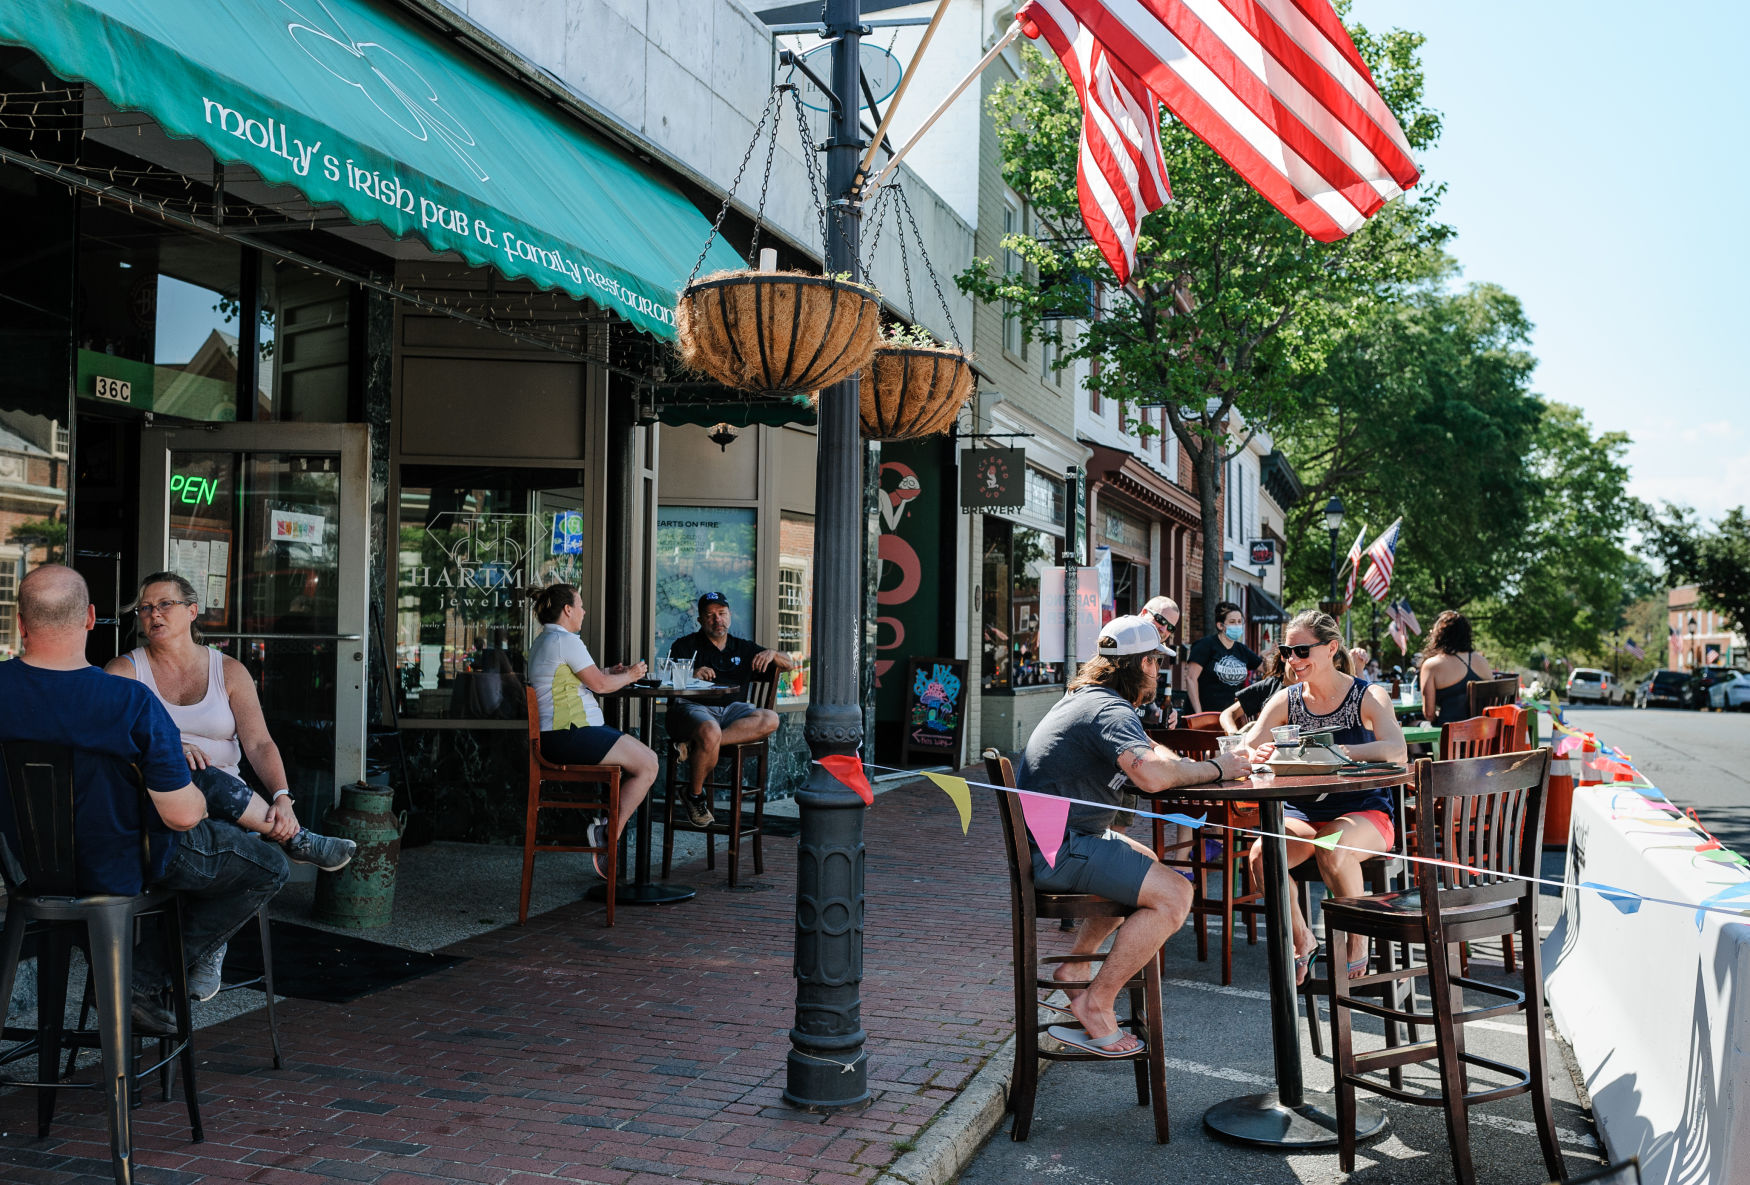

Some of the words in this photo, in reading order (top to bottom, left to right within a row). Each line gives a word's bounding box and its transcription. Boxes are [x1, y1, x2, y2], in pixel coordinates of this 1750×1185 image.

[582, 266, 677, 327] restauran
[97, 378, 129, 401] 36C
[170, 475, 218, 505] PEN
[962, 506, 1024, 515] BREWERY
[657, 520, 684, 528] EARTS
[685, 520, 698, 528] ON
[699, 521, 719, 529] FIRE
[411, 566, 568, 589] HARTMAN
